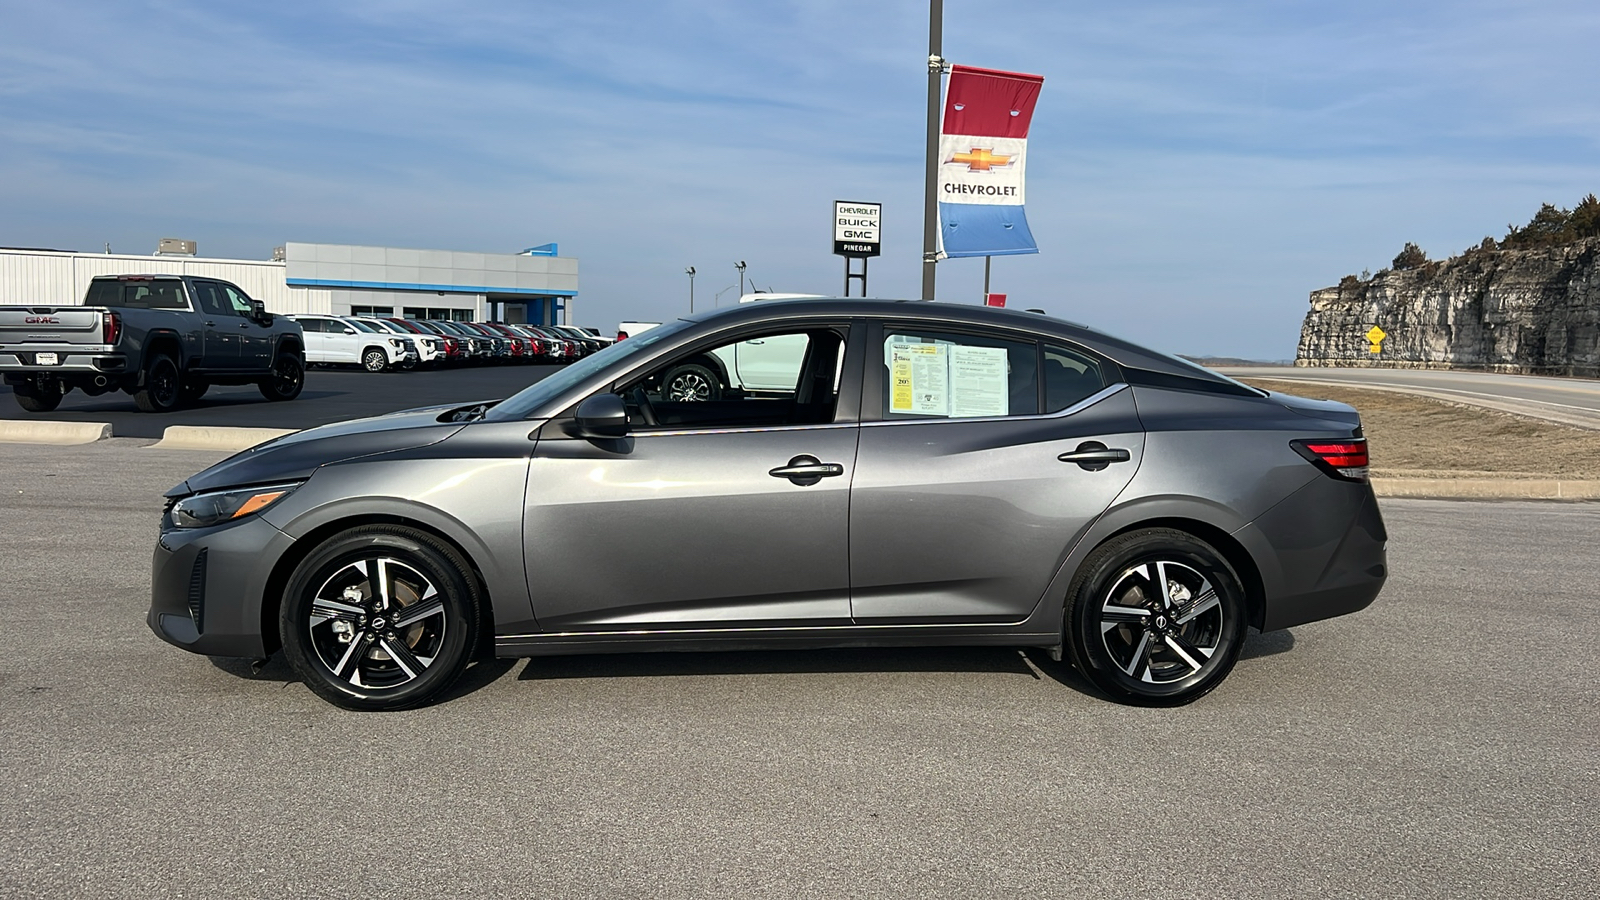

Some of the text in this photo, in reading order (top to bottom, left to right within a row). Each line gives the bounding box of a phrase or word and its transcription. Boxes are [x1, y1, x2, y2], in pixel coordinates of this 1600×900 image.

[944, 183, 1016, 196] CHEVROLET
[840, 207, 877, 215] CHEVROLET
[838, 218, 877, 227] BUICK
[844, 230, 872, 239] GMC
[843, 244, 872, 252] PINEGAR
